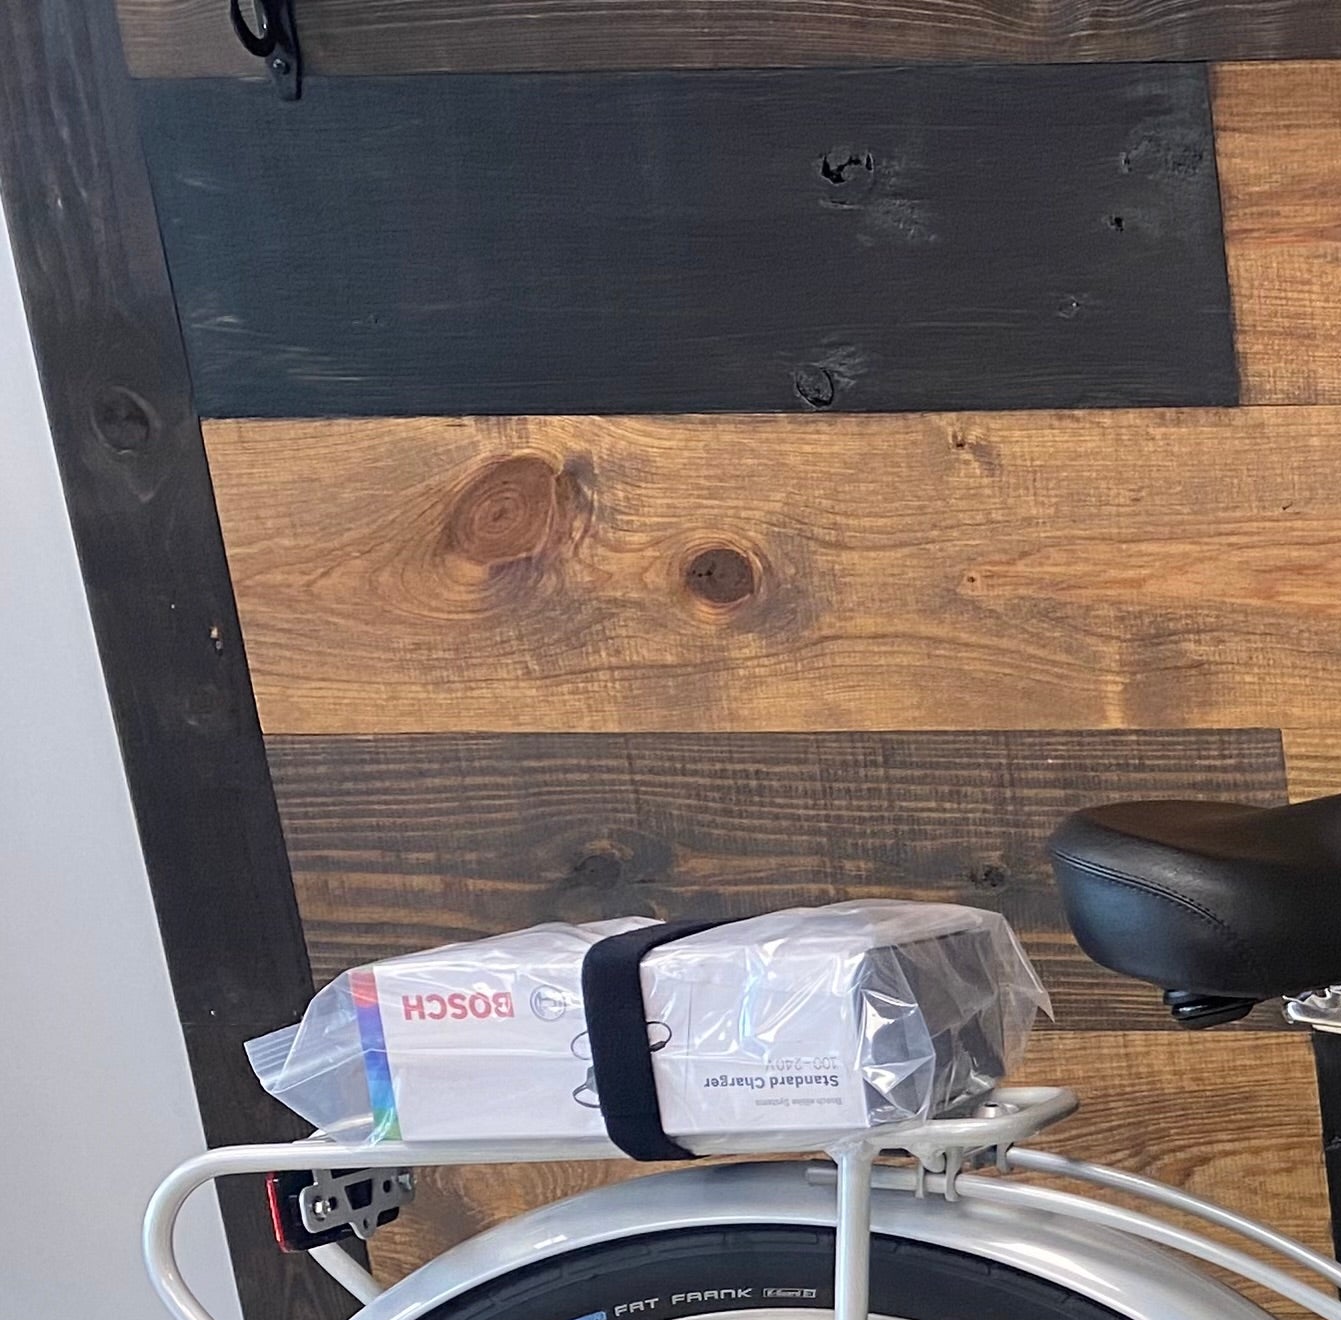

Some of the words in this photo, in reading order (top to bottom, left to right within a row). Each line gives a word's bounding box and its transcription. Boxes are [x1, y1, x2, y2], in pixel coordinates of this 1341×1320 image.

[401, 991, 515, 1022] BOSCH
[703, 1074, 766, 1090] Charger
[769, 1074, 840, 1089] Standard
[614, 1297, 660, 1318] FAT
